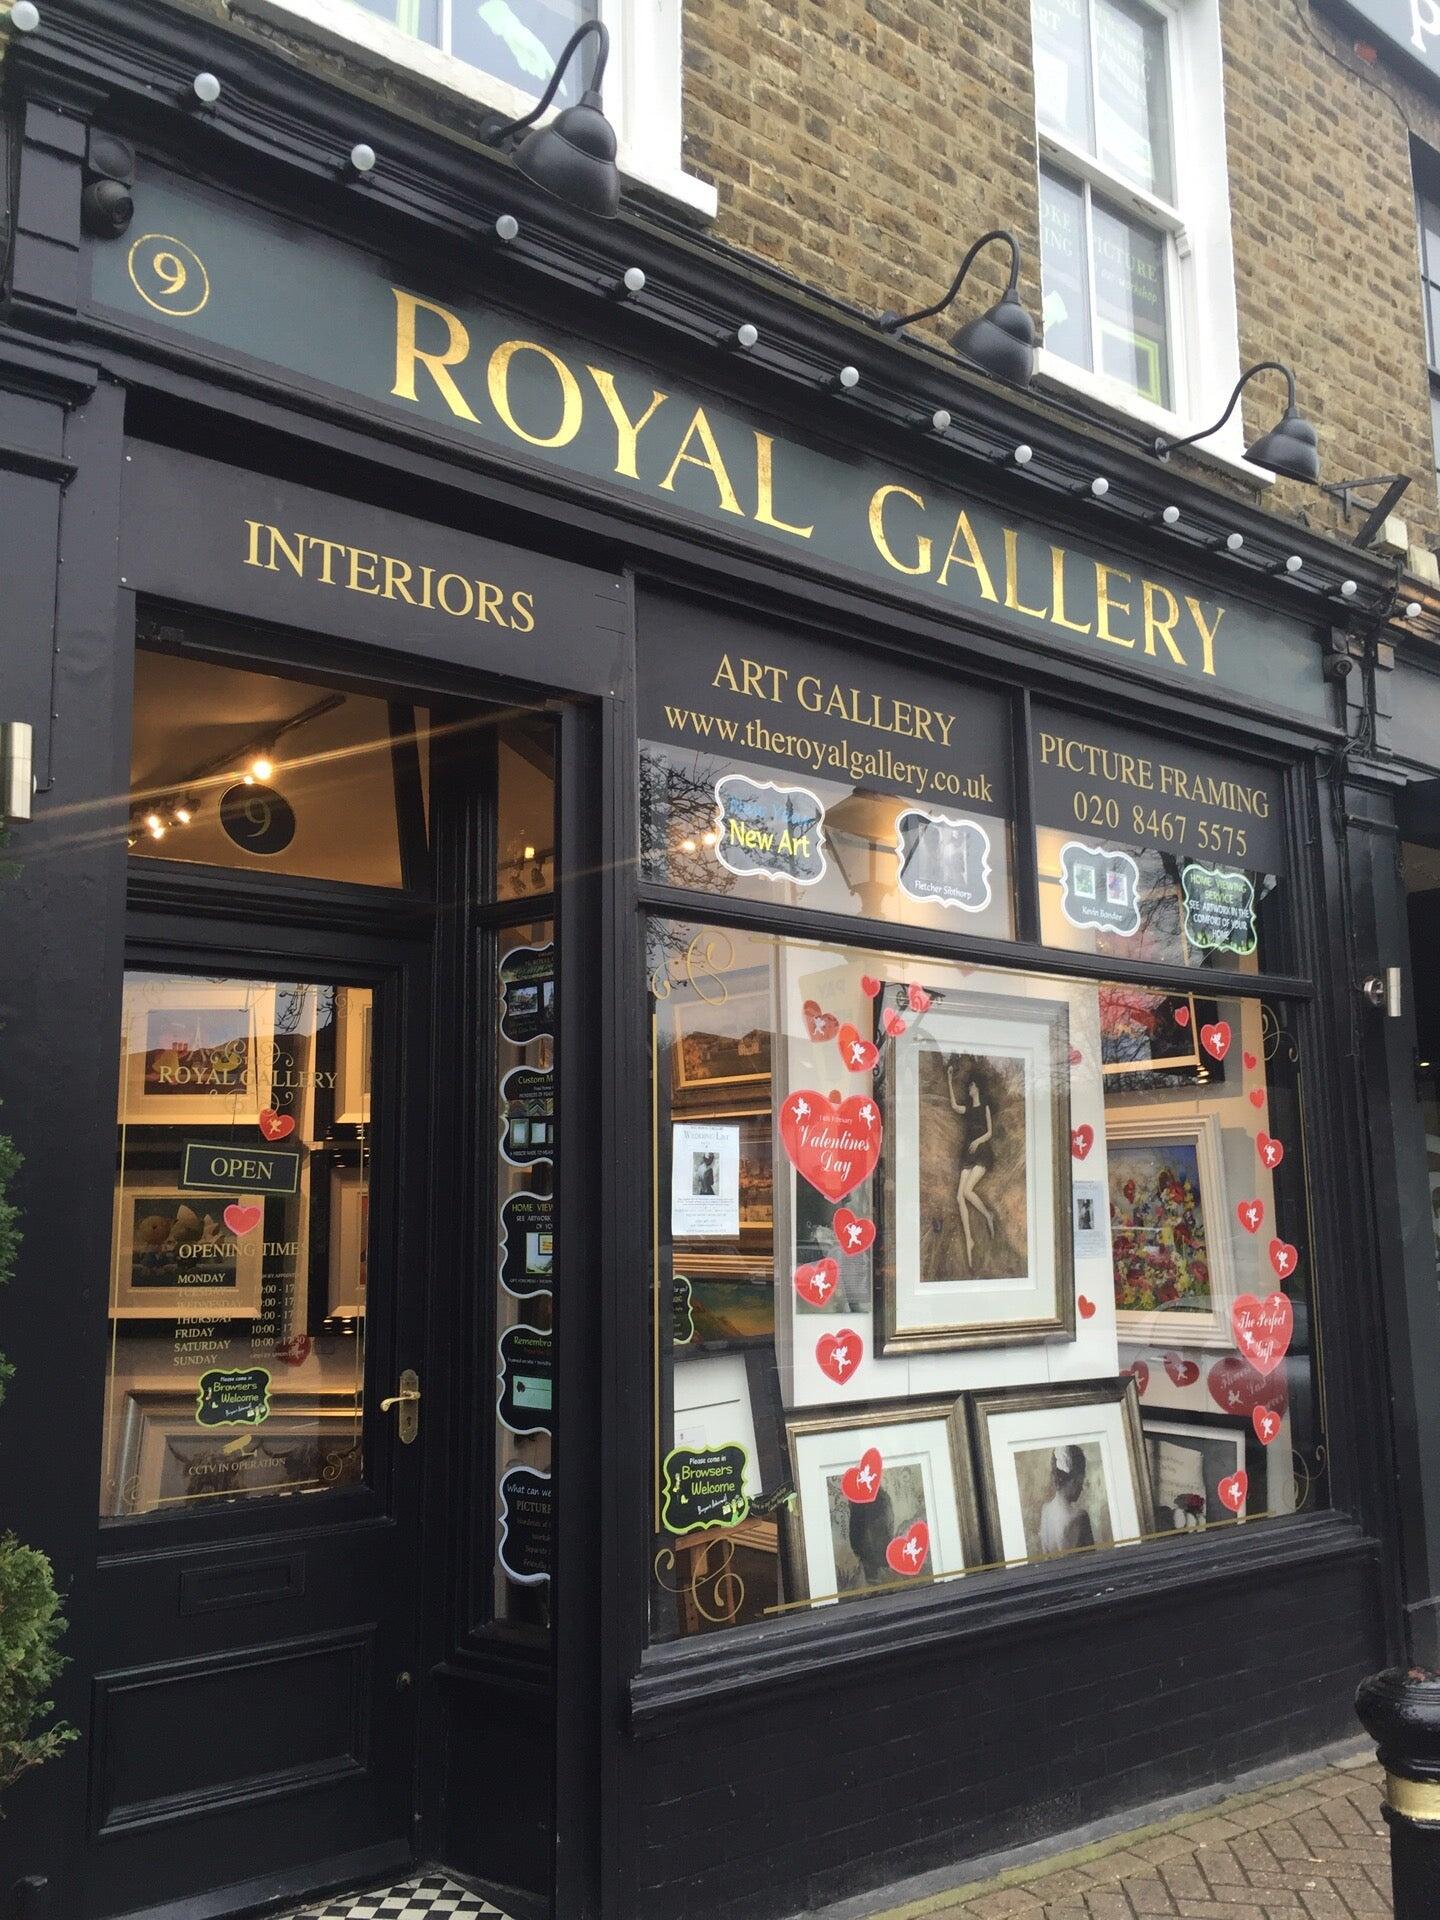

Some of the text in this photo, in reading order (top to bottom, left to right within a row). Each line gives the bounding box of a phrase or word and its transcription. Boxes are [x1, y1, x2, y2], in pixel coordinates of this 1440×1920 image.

[153, 252, 186, 295] 9
[390, 288, 1226, 677] ROYAL GALLERY
[243, 519, 536, 633] INTERIORS
[711, 653, 956, 748] ART GALLERY
[664, 705, 993, 803] www.theroyalgallery.co.uk
[1039, 732, 1270, 819] PICTURE FRAMING
[244, 798, 272, 838] 9
[1073, 791, 1248, 857] 020 8467 5575
[729, 818, 811, 858] New Art
[1190, 874, 1213, 887] HOME
[158, 1065, 338, 1089] ROYAL GALLERY
[518, 1075, 545, 1085] Custom
[801, 1125, 871, 1152] Valentines
[210, 1157, 274, 1180] OPEN
[820, 1150, 852, 1182] Day
[512, 1203, 535, 1213] HOME
[179, 1242, 256, 1259] OPENING
[177, 1273, 226, 1284] MONDAY
[251, 1324, 275, 1334] 10:00
[1238, 1310, 1287, 1334] The Perfect
[175, 1327, 215, 1339] FRIDAY
[174, 1340, 232, 1352] SATURDAY
[251, 1337, 275, 1348] 10:00
[514, 1335, 552, 1348] Remembra
[173, 1354, 218, 1367] SUNDAY
[213, 1382, 258, 1392] Browsers
[221, 1393, 260, 1403] Welcome
[188, 1457, 287, 1476] CCTV IN OPERATION
[689, 1457, 706, 1465] Please
[681, 1465, 734, 1480] Browsers
[507, 1483, 525, 1494] What
[526, 1487, 540, 1496] can
[691, 1481, 736, 1496] Welcome
